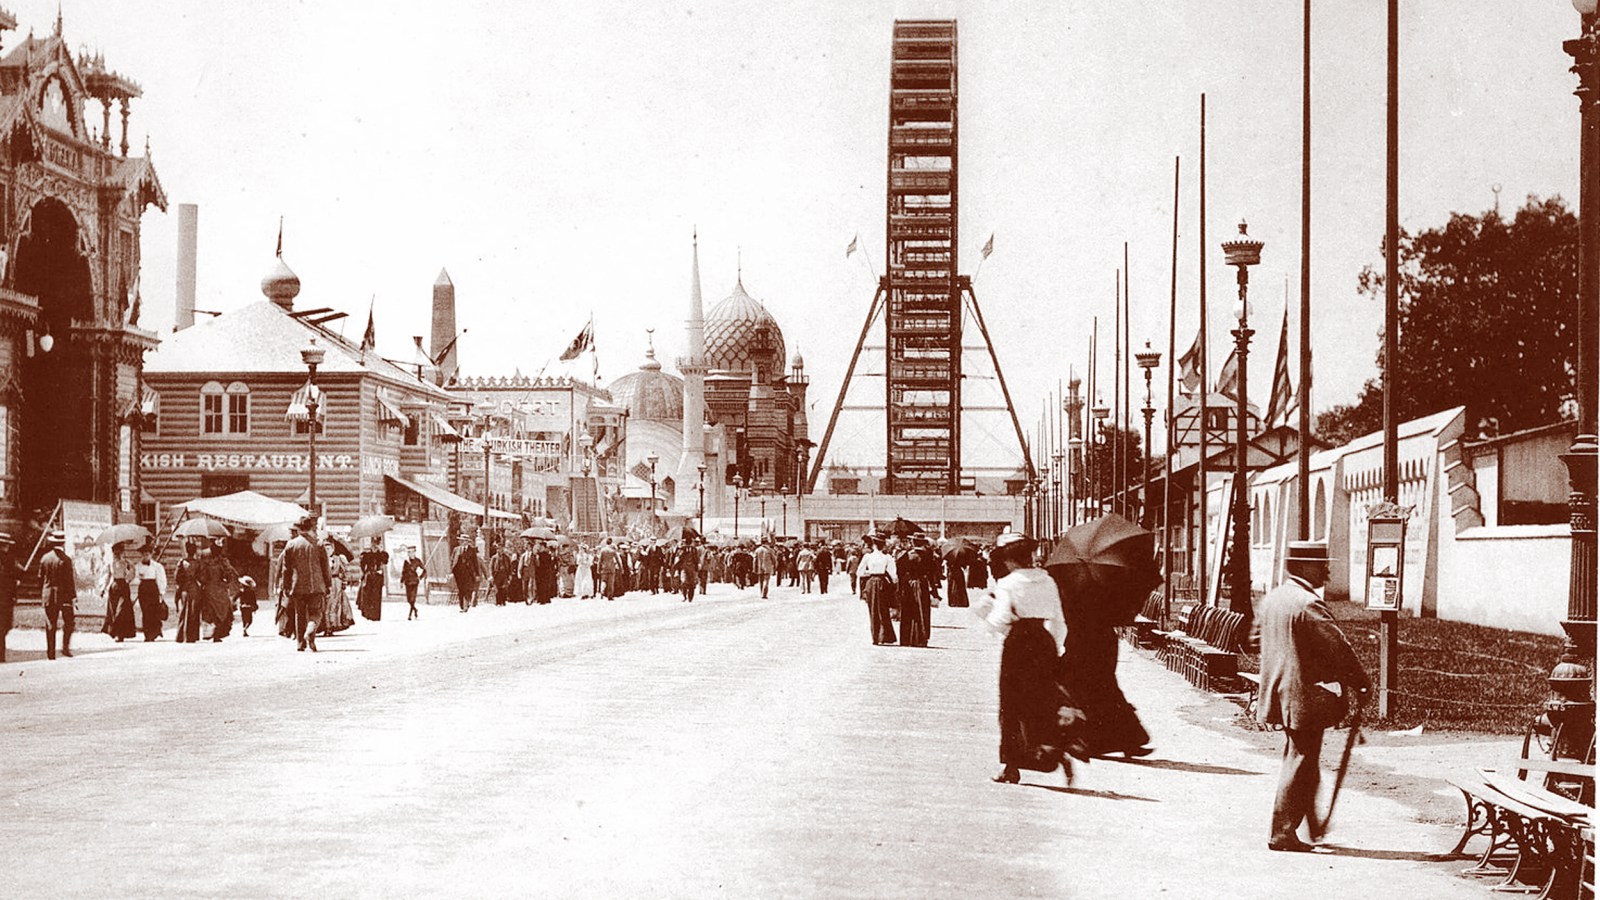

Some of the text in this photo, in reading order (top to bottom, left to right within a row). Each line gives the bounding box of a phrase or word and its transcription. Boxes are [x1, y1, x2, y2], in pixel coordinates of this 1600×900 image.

[489, 439, 522, 453] URKISH
[524, 441, 560, 455] THEATER
[140, 453, 184, 468] KISH
